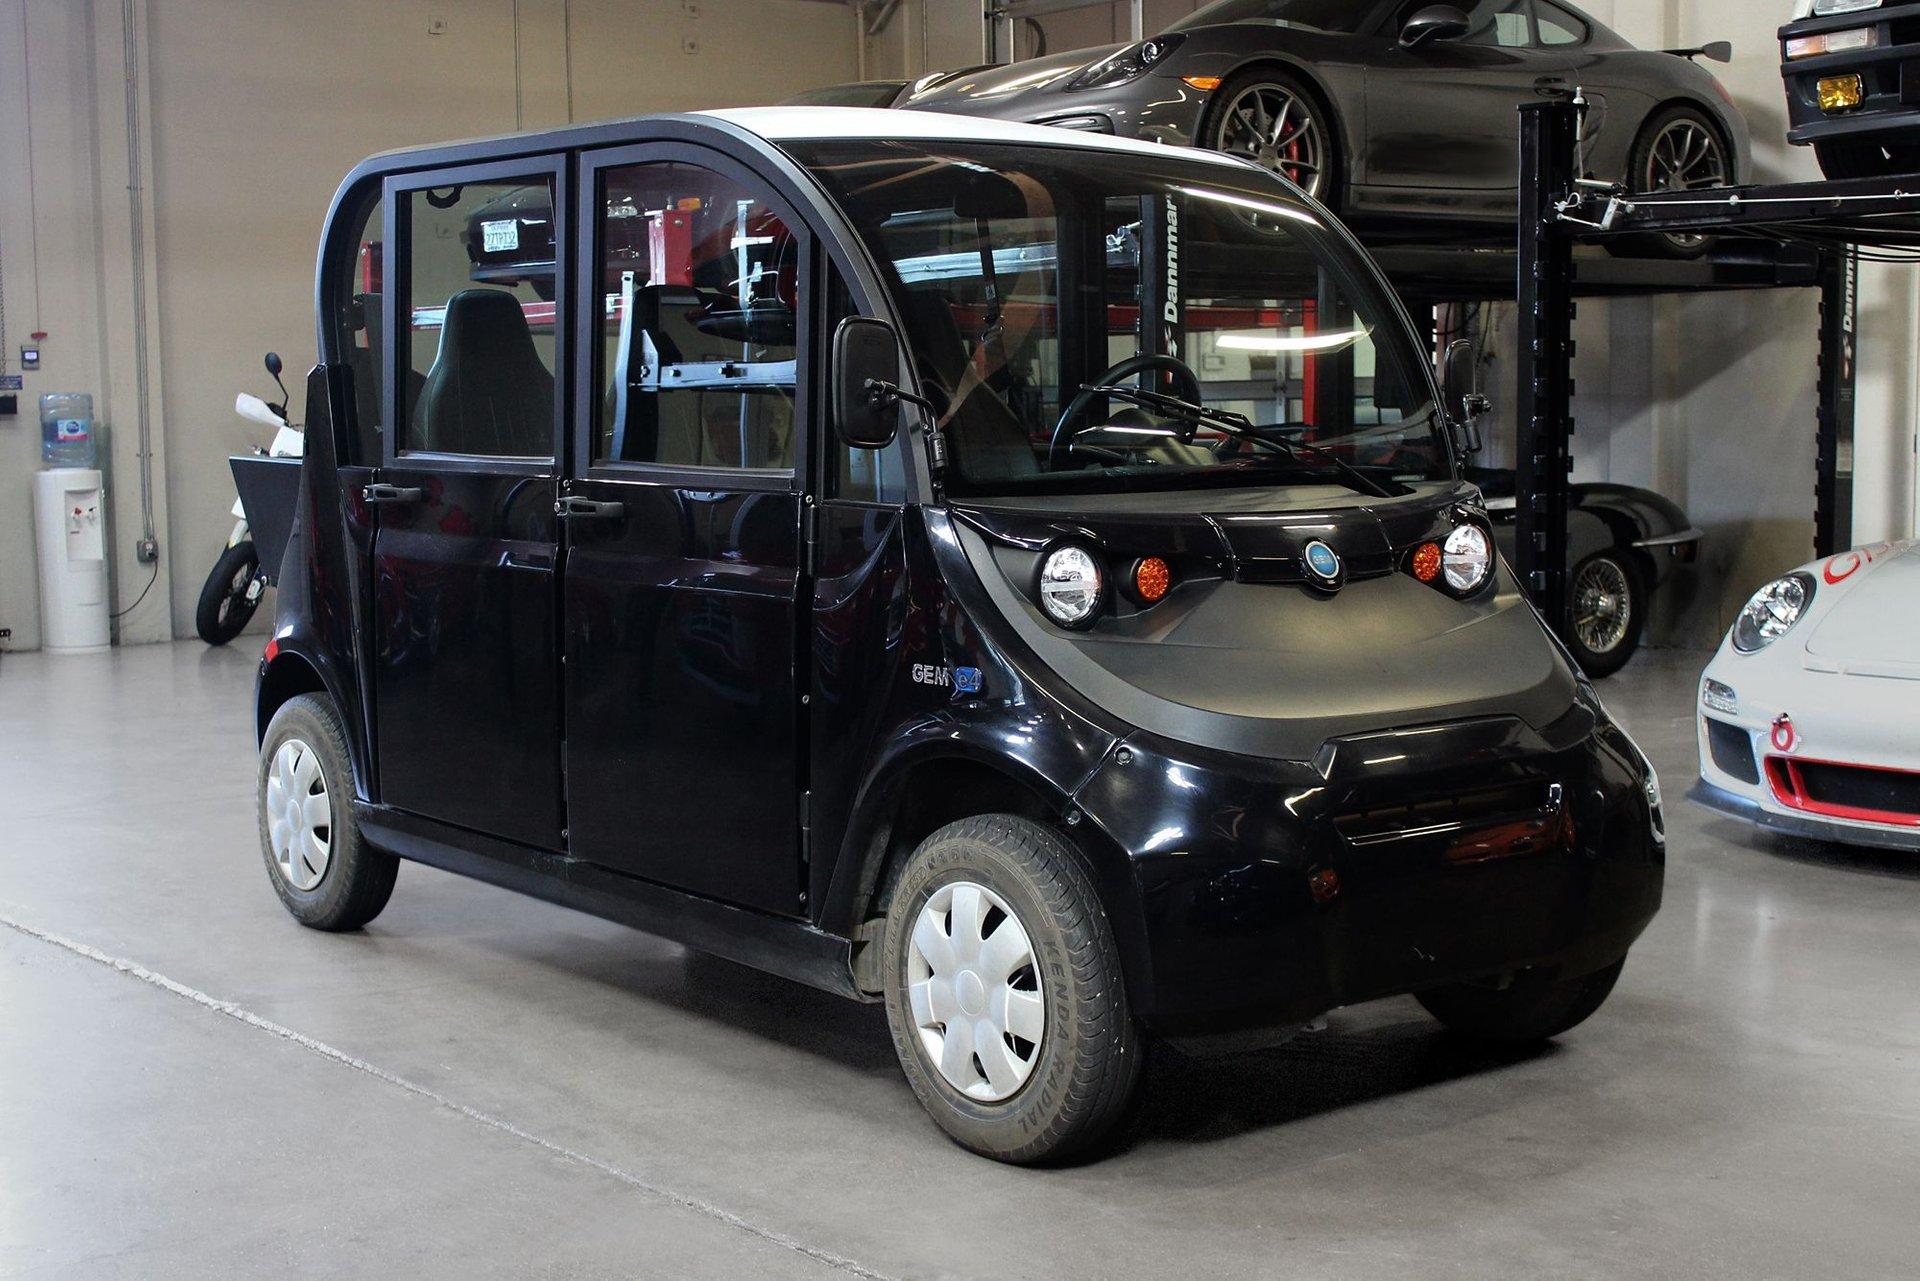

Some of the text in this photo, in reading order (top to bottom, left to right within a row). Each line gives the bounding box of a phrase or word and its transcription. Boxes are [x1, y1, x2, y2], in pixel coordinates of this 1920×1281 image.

[1165, 199, 1178, 324] Dannmar
[912, 663, 982, 690] GEM e4
[1019, 941, 1069, 1135] KENDA RADIAL
